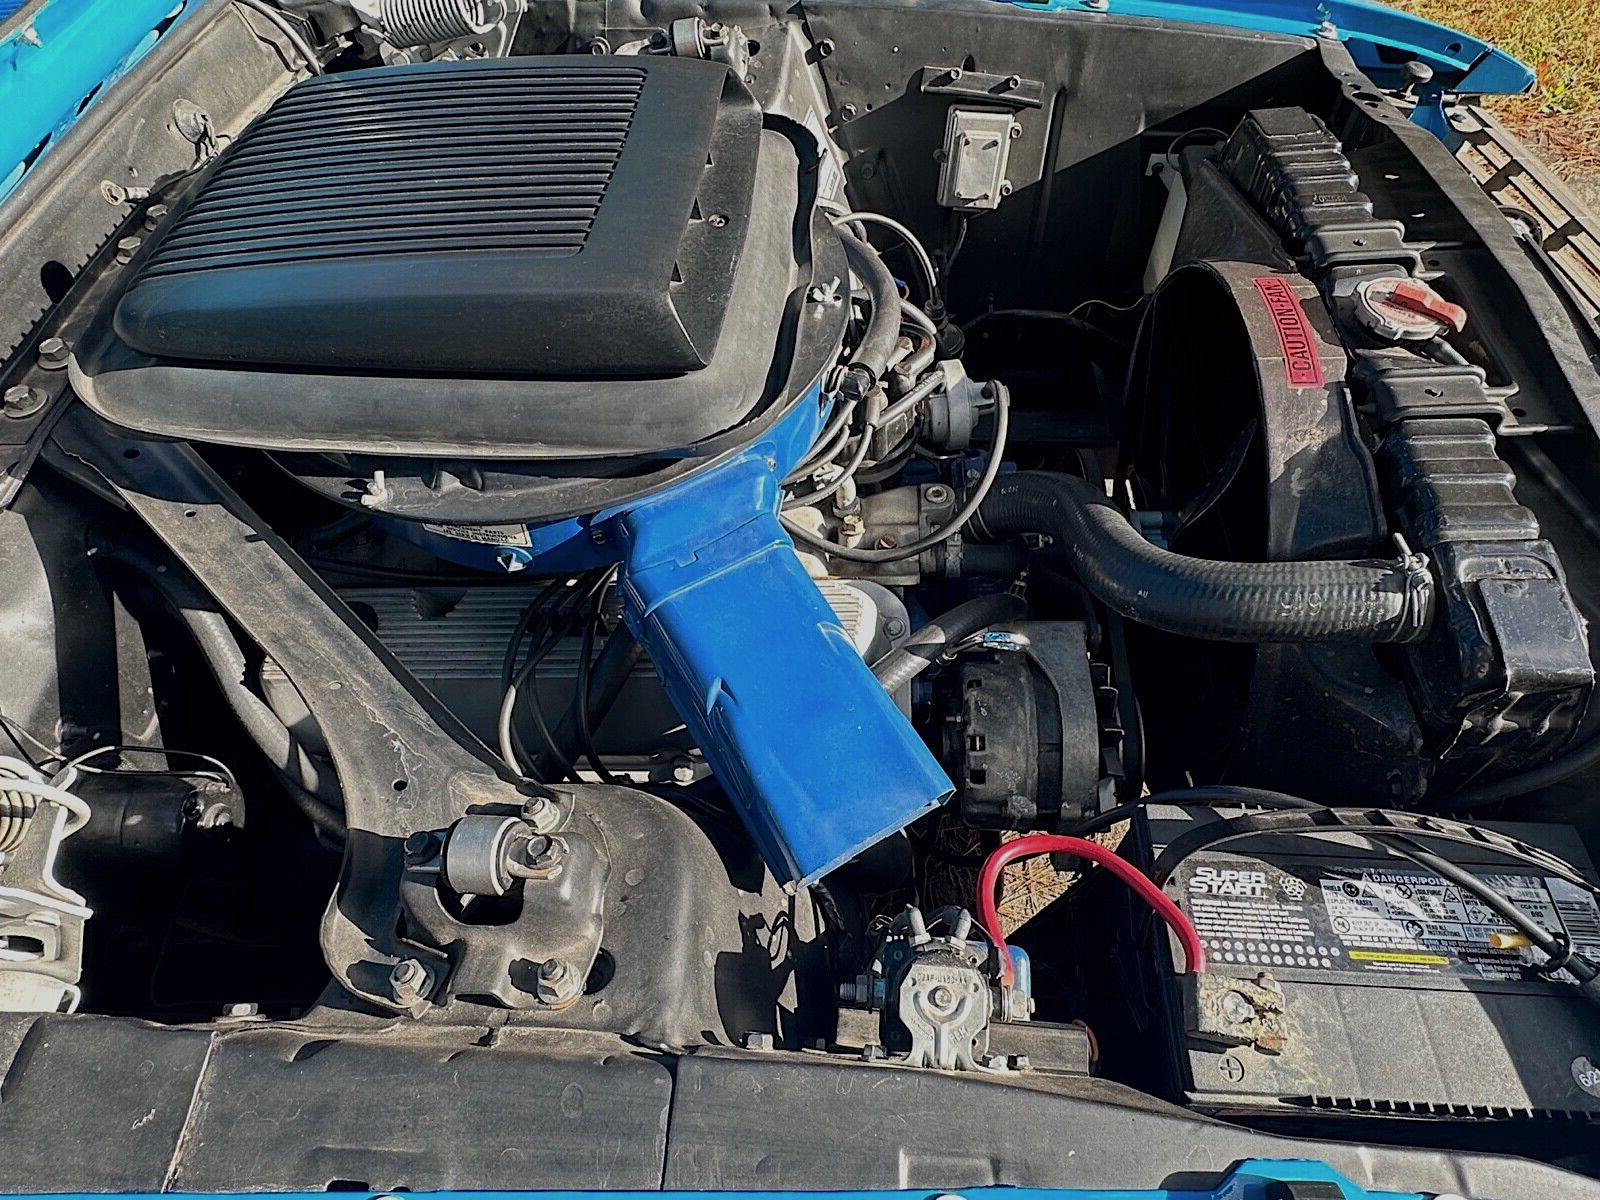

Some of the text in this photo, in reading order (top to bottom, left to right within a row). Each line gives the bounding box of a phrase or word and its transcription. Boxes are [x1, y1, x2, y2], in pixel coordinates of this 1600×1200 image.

[1195, 866, 1267, 883] SUPER
[1373, 874, 1453, 886] DANGER/POIS
[1188, 877, 1268, 896] START
